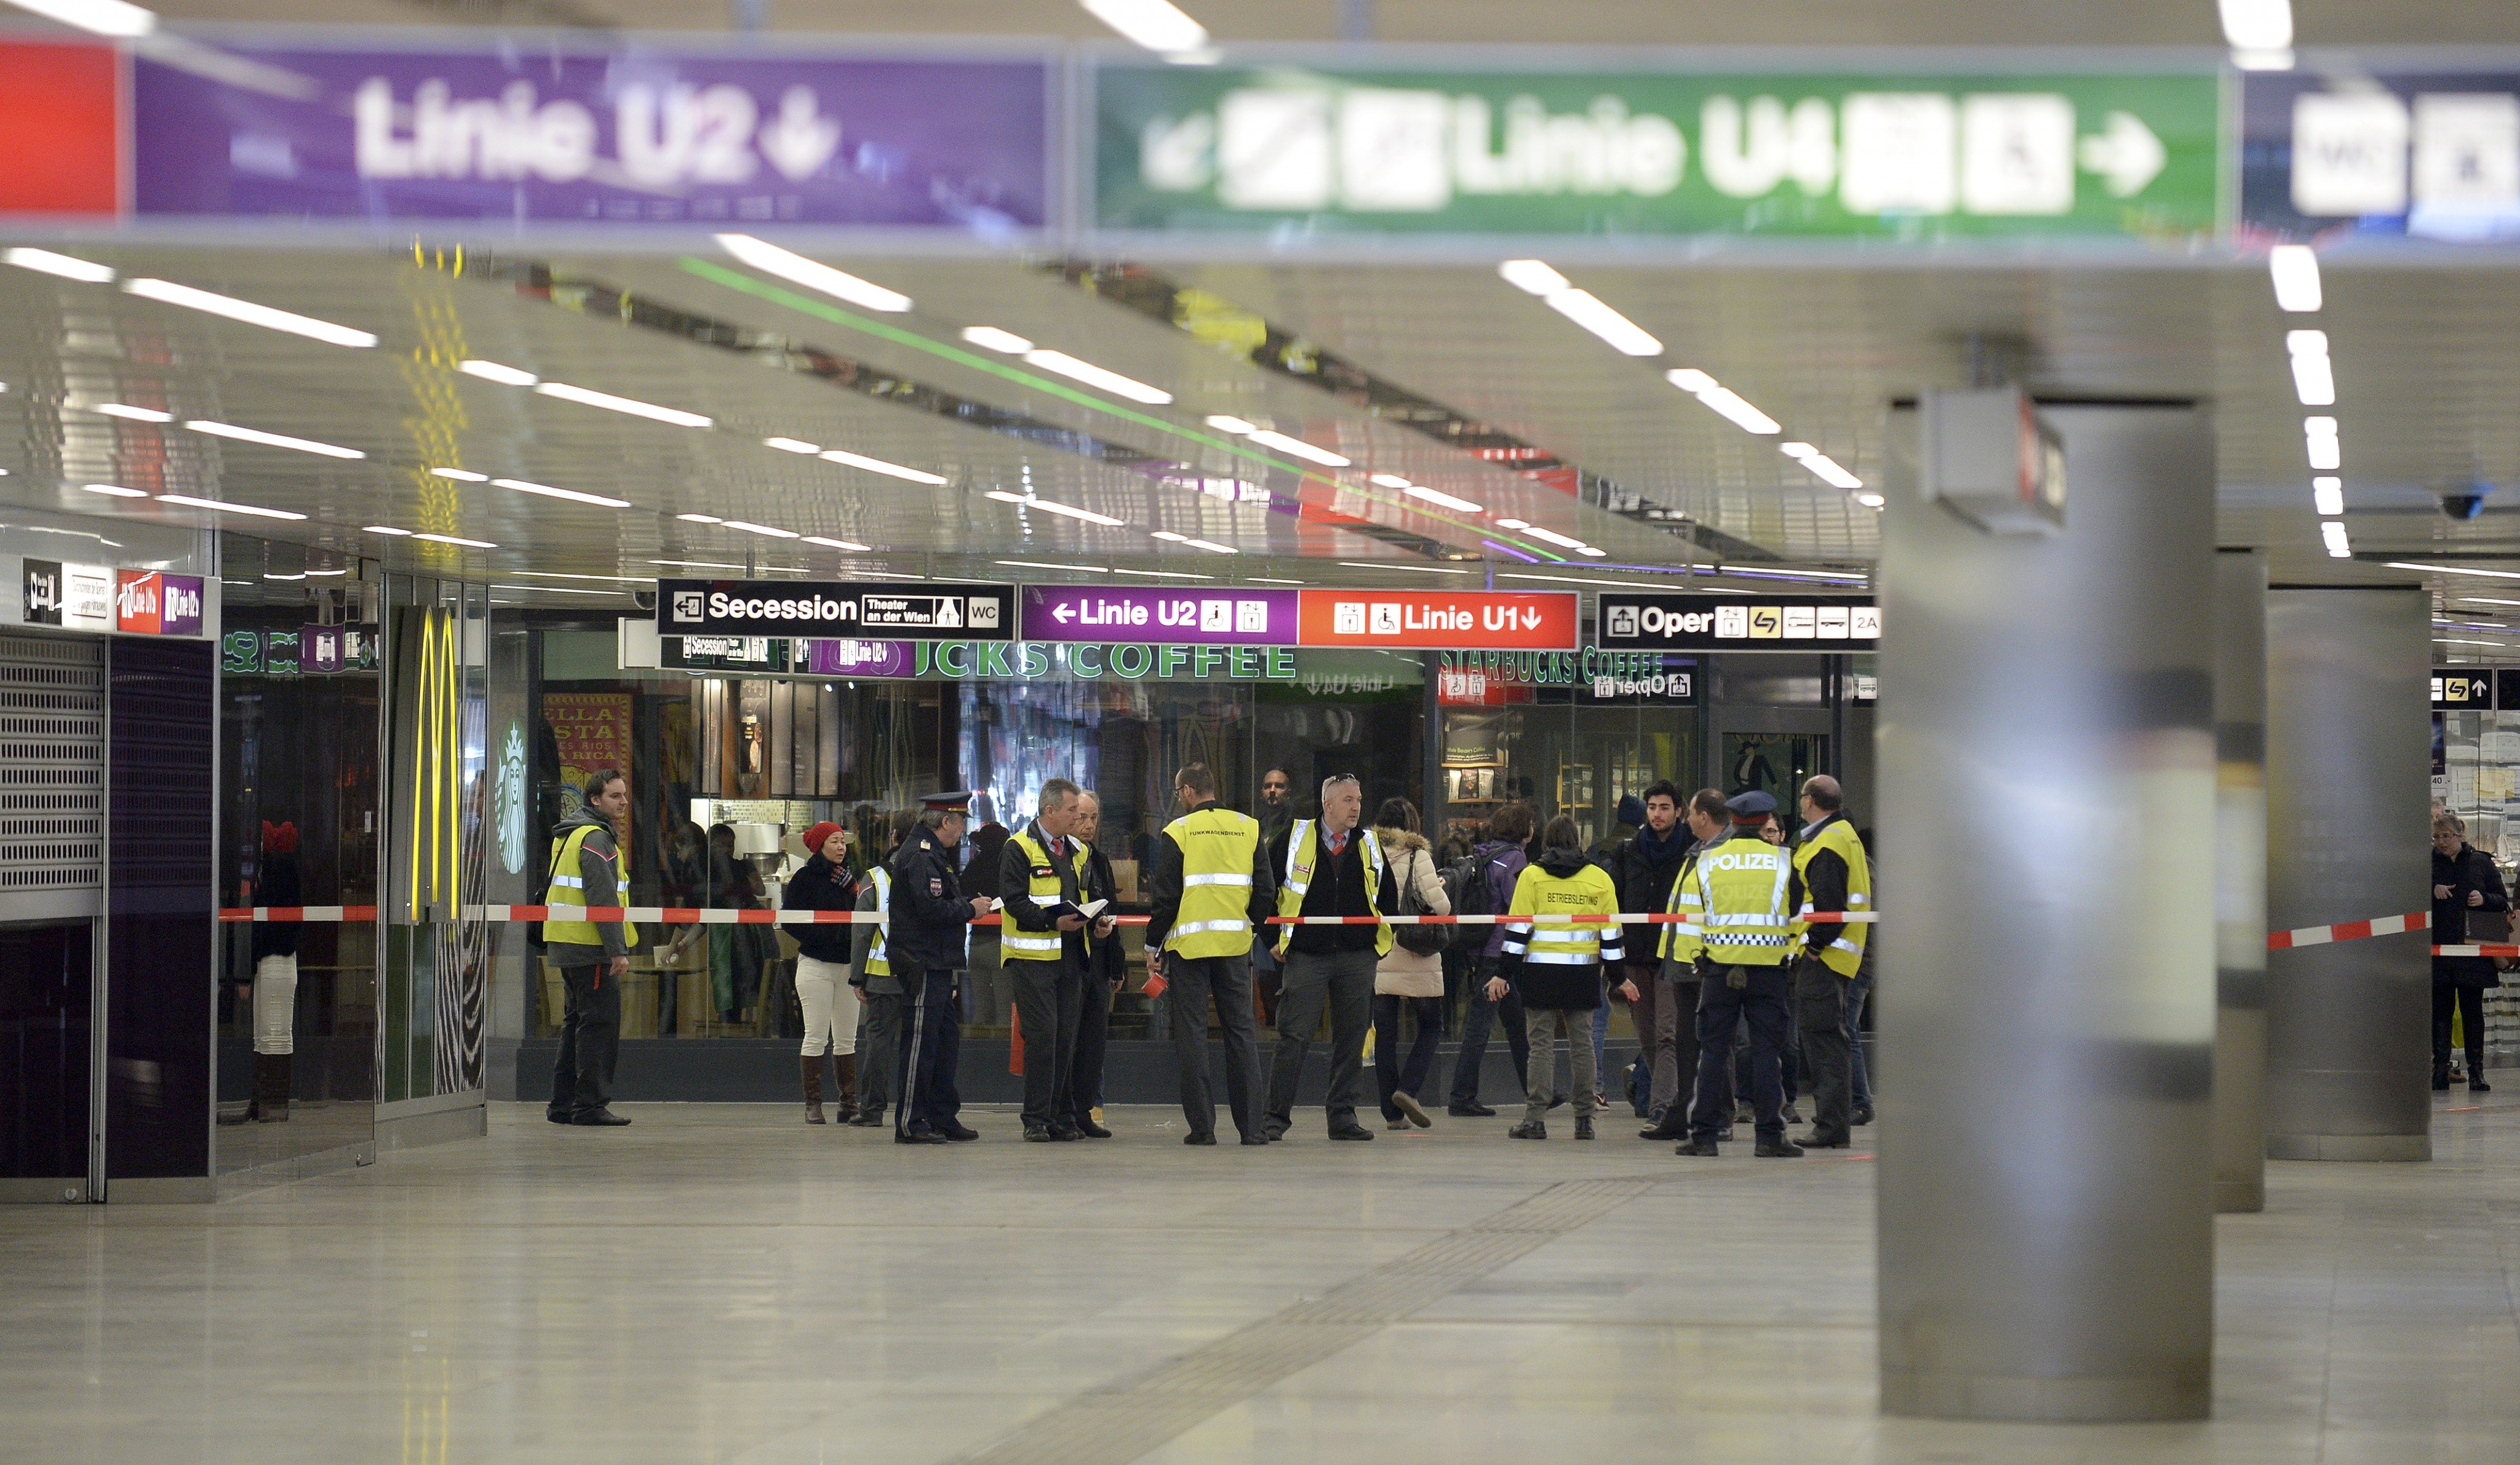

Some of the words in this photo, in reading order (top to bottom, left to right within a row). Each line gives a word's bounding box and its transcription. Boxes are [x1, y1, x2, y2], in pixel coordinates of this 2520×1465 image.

[357, 78, 597, 178] Linie
[619, 84, 759, 183] U2
[1456, 94, 1685, 195] Linie
[1701, 95, 1836, 196] U4
[709, 592, 857, 620] Secession
[867, 599, 908, 610] Theater
[971, 606, 996, 619] WC
[1080, 599, 1149, 626] Linie
[1158, 600, 1197, 626] U2
[867, 612, 880, 621] an
[883, 612, 901, 622] der
[903, 612, 930, 623] Wien
[1405, 604, 1474, 630] Linie
[1483, 605, 1517, 631] U1
[1640, 606, 1715, 638] Oper
[1857, 617, 1878, 628] 2A
[692, 636, 727, 656] Secession
[856, 641, 872, 661] Linie
[872, 642, 882, 663] U2
[1068, 643, 1296, 678] COFFEE
[1440, 650, 1576, 684] STARBUCKS
[1582, 645, 1663, 685] COFFEE
[572, 751, 616, 760] RICA
[1709, 853, 1778, 872] POLIZEI
